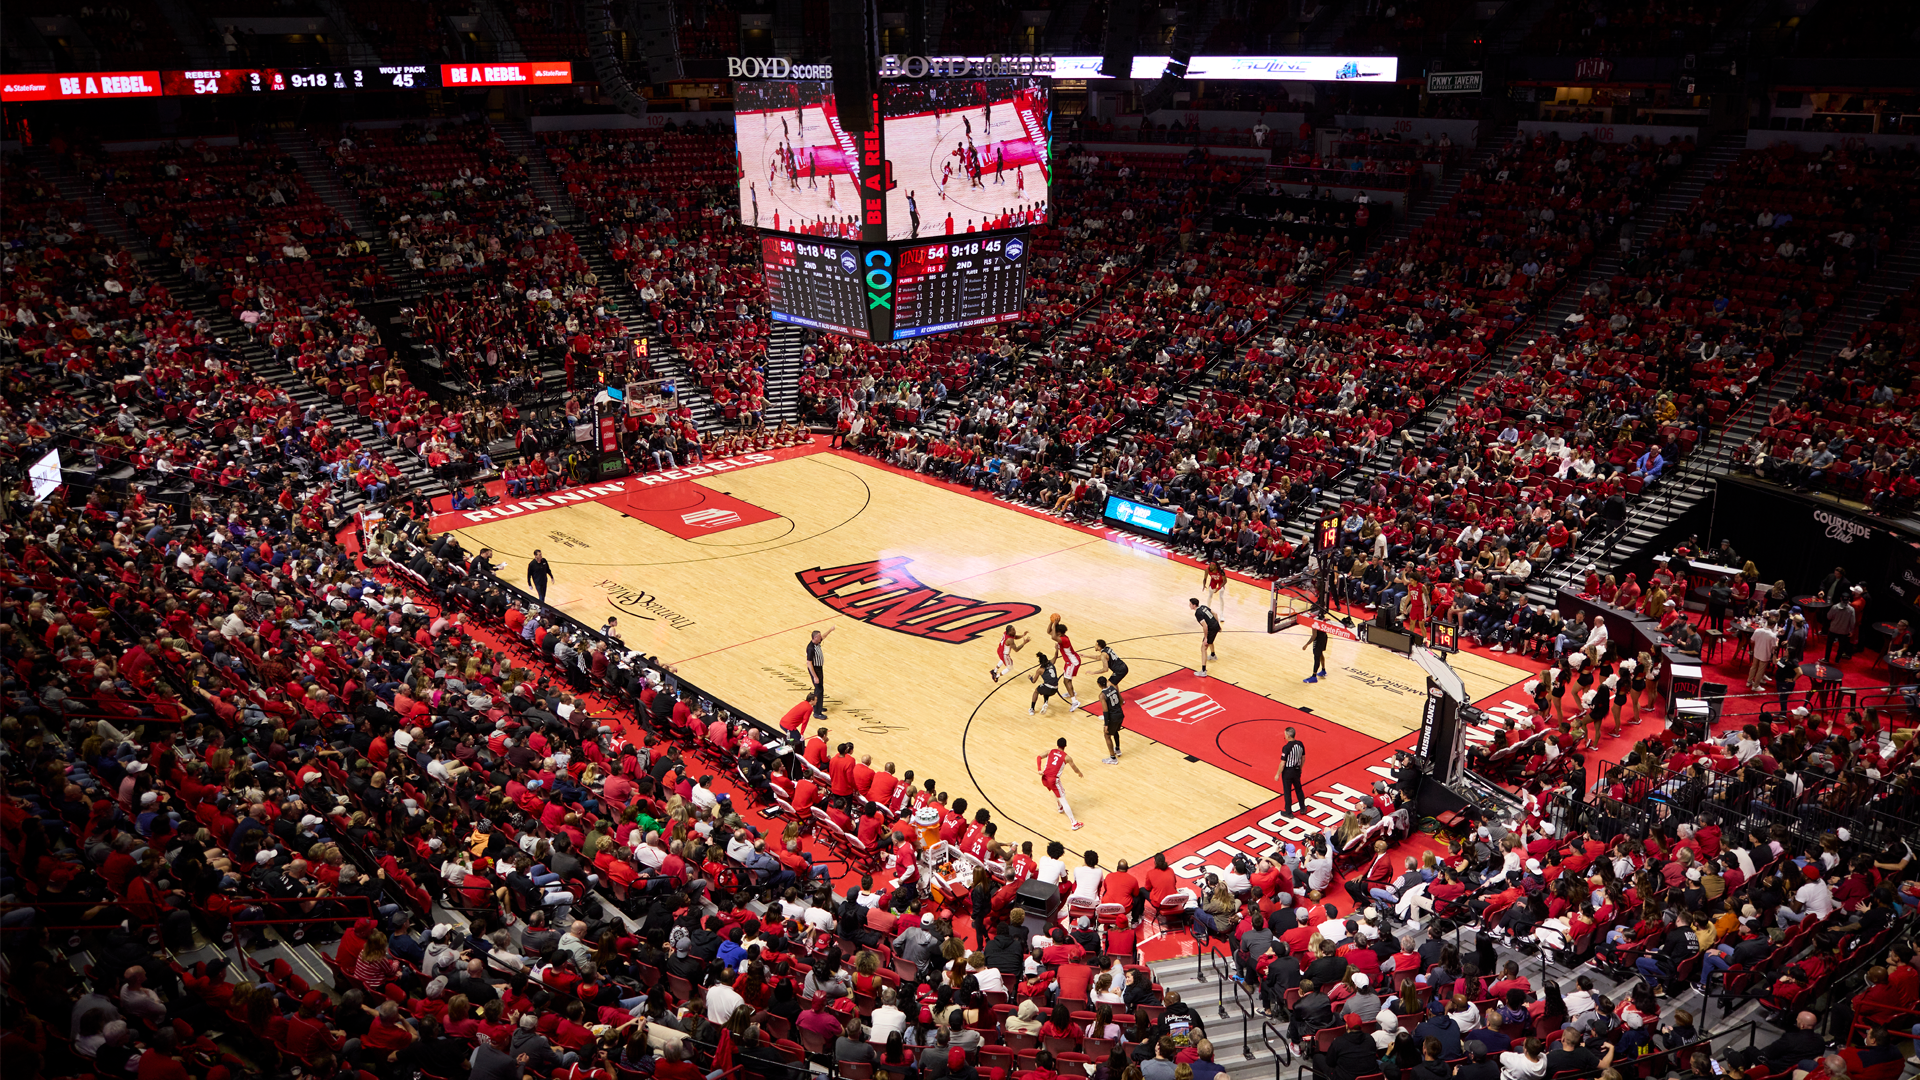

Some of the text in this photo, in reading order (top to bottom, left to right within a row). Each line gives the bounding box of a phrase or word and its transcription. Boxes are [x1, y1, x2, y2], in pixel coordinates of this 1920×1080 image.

[379, 66, 426, 74] WOLF PACK
[727, 56, 833, 79] BOYD SCOREB
[881, 54, 1056, 78] BOYD SCOREBOARD
[185, 71, 221, 79] REBELS
[250, 73, 260, 85] 3
[274, 74, 282, 83] 8
[291, 73, 327, 88] 9:18
[334, 72, 342, 82] 7
[353, 70, 363, 82] 3
[392, 74, 414, 87] 45
[451, 66, 527, 83] BE A REBEL.
[1432, 75, 1480, 86] PKWY TAVERN
[59, 75, 153, 95] BE A REBEL.
[194, 79, 218, 94] 54
[647, 115, 664, 126] 102
[1395, 120, 1412, 132] 105
[1594, 127, 1614, 140] 106
[865, 174, 881, 191] A
[866, 198, 882, 225] BE
[780, 241, 837, 260] 54 9:18 45
[928, 240, 1001, 260] 54 9:18 45
[900, 249, 927, 268] UNLV
[994, 257, 999, 265] 7
[956, 261, 972, 270] 2ND
[865, 250, 892, 310] COX
[636, 345, 648, 358] 19
[462, 453, 776, 522] RUNNIN' REBELS
[1134, 506, 1151, 519] DRIP
[1323, 517, 1339, 530] 9:18
[1813, 510, 1872, 540] COURTSIDE
[1323, 528, 1336, 548] 19
[1825, 524, 1854, 544] Club
[795, 555, 1042, 645] UNLV
[645, 598, 696, 631] Thomas
[1440, 635, 1451, 646] 19
[1341, 666, 1376, 679] FIRST
[1377, 677, 1428, 696] AMERICA
[1673, 682, 1698, 695] UNLV
[1420, 725, 1432, 757] RAISING
[1426, 695, 1437, 725] CANE'S
[1051, 757, 1059, 765] 2
[893, 787, 903, 798] 15
[967, 828, 975, 838] 3
[972, 843, 981, 855] 22
[1015, 864, 1024, 875] 31
